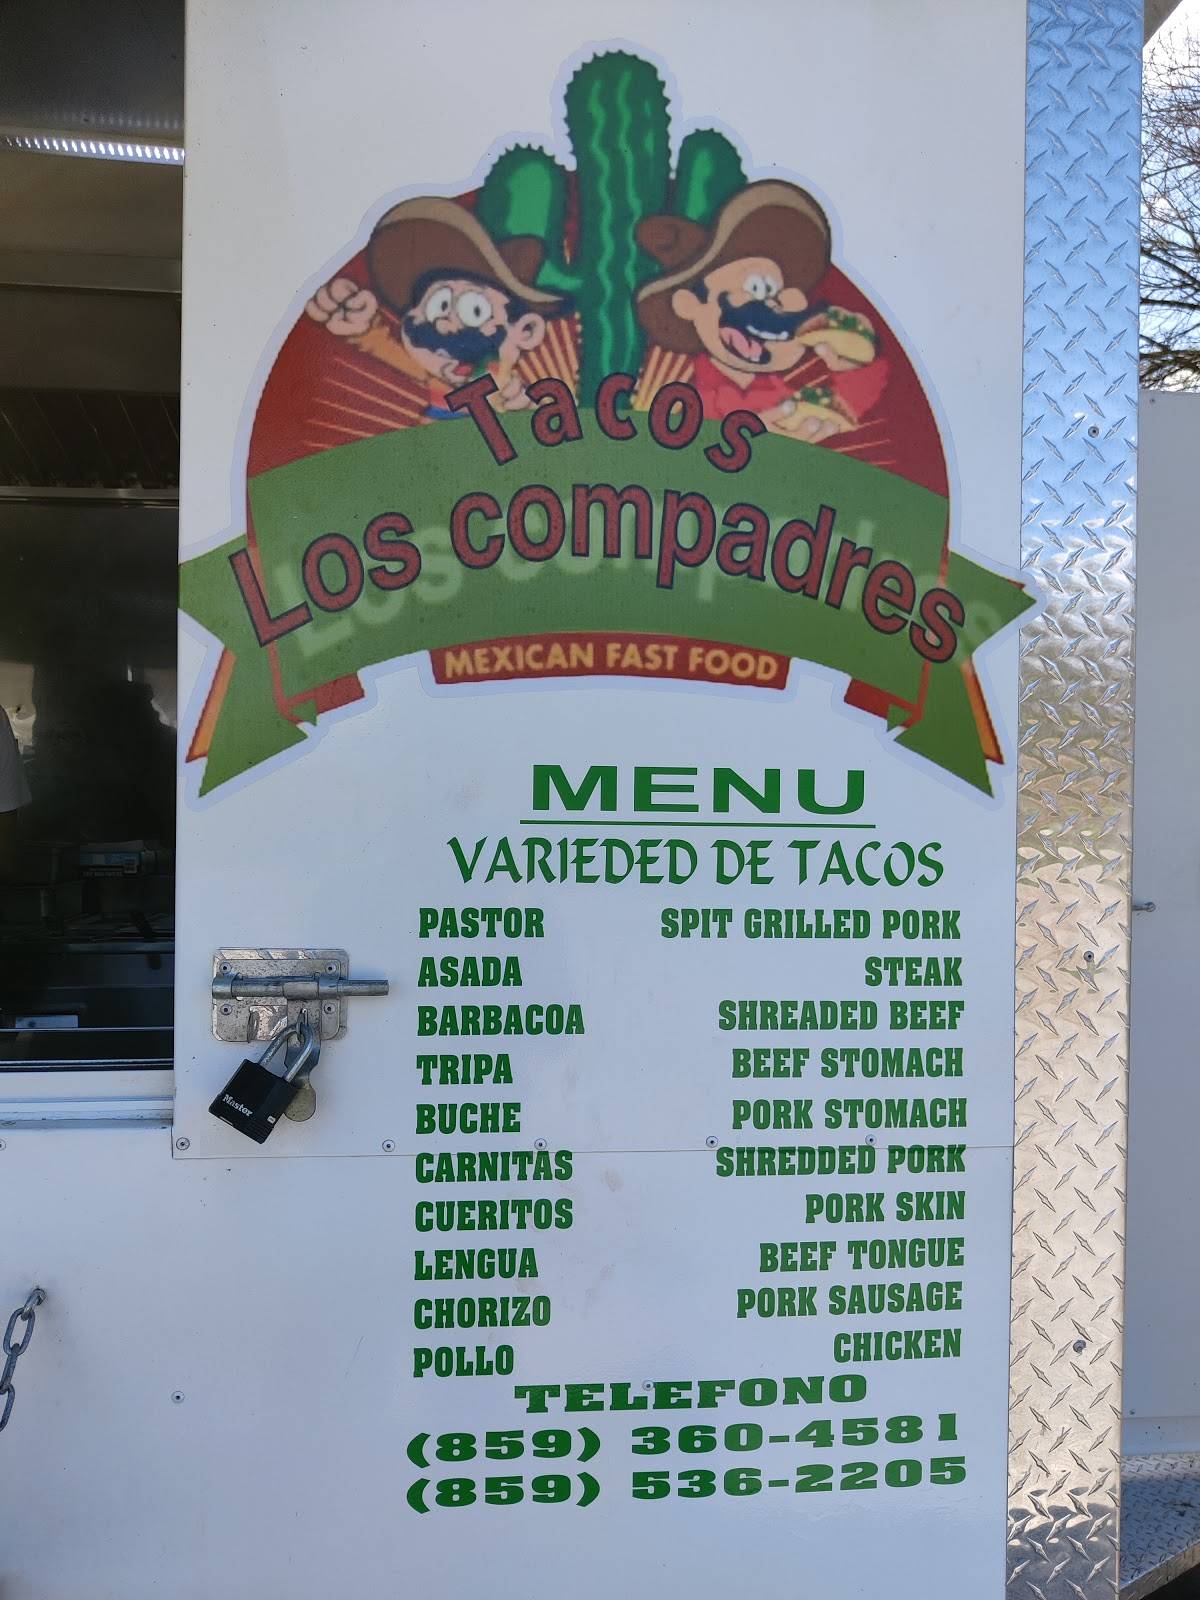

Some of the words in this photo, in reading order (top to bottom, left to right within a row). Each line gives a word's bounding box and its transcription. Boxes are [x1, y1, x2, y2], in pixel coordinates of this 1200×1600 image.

[444, 373, 768, 473] Tacos
[228, 512, 421, 647] Los
[450, 483, 965, 663] compadres
[445, 643, 594, 678] MEXICAN
[606, 645, 678, 671] FAST
[689, 648, 778, 681] FOOD
[531, 764, 864, 815] MENU
[447, 837, 698, 884] VARIEDED
[711, 838, 771, 884] DE
[788, 839, 944, 886] TACOS
[418, 907, 544, 939] PASTOR
[660, 908, 732, 938] SPIT
[743, 908, 870, 939] GRILLED
[882, 909, 960, 939] PORK
[417, 955, 521, 987] ASADA
[865, 956, 960, 986] STEAK
[417, 1003, 584, 1036] BARBACOA
[718, 1000, 877, 1029] SHREADED
[889, 1000, 964, 1030] BEEF
[415, 1053, 512, 1085] TRIPA
[733, 1047, 809, 1077] BEEF
[820, 1047, 963, 1077] STOMACH
[222, 1093, 254, 1117] Master
[414, 1103, 521, 1135] BUCHE
[732, 1099, 812, 1129] PORK
[825, 1098, 967, 1129] STOMACH
[414, 1150, 572, 1184] CARNITAS
[716, 1145, 876, 1176] SHREDDED
[887, 1143, 965, 1173] PORK
[414, 1199, 572, 1232] CUERITOS
[805, 1193, 884, 1223] PORK
[896, 1191, 965, 1221] SKIN
[414, 1247, 537, 1280] LENGUA
[759, 1242, 836, 1272] BEEF
[846, 1237, 964, 1269] TONGUE
[413, 1295, 550, 1328] CHORIZO
[737, 1287, 816, 1317] PORK
[829, 1280, 961, 1315] SAUSAGE
[413, 1344, 513, 1377] POLLO
[833, 1328, 961, 1362] CHICKEN
[513, 1375, 866, 1412] TELEFONO
[406, 1427, 600, 1468] (859)
[632, 1413, 956, 1455] 360-4581
[406, 1472, 600, 1512] (859)
[632, 1455, 965, 1500] 536-2205
